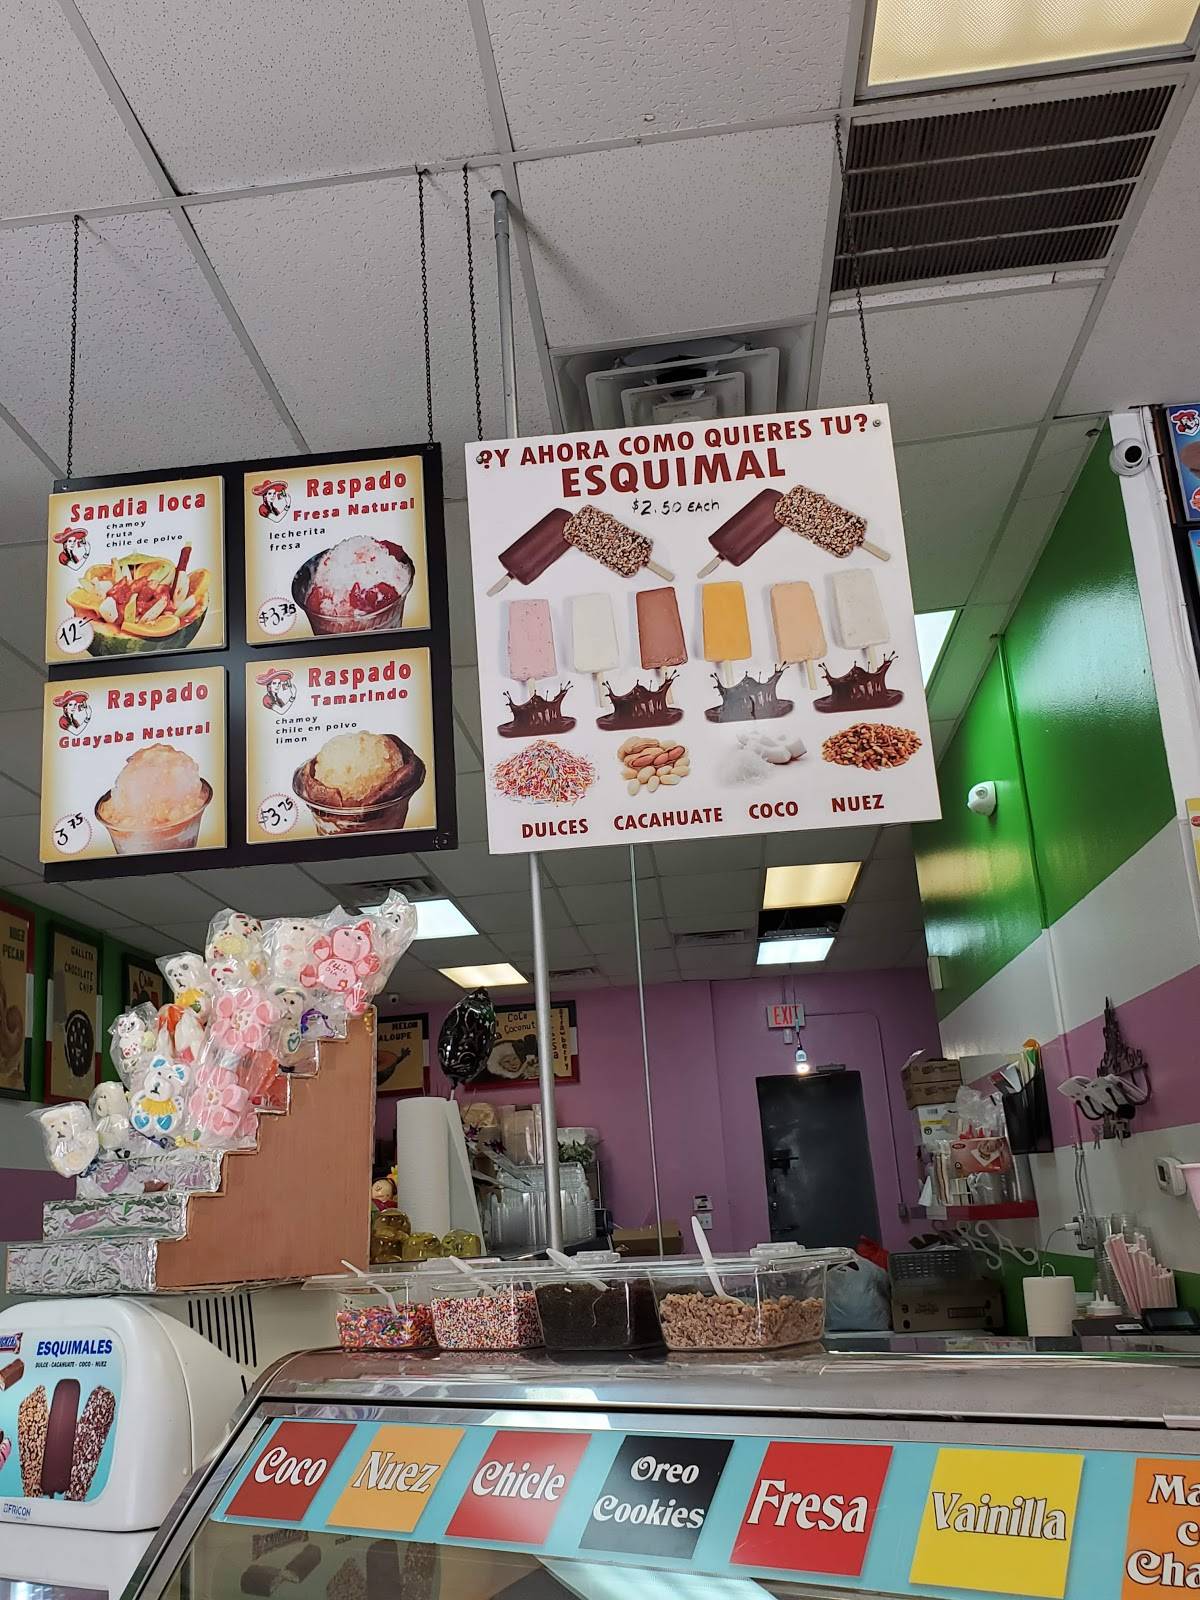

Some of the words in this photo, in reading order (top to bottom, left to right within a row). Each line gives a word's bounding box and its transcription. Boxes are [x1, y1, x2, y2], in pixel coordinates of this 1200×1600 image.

[520, 440, 610, 466] AHORA
[618, 431, 694, 457] COMO
[704, 418, 812, 448] QUIERES
[820, 413, 868, 436] TU?
[306, 470, 407, 499] Raspado
[561, 447, 786, 498] ESQUIMAL
[70, 498, 148, 523] Sandia
[158, 492, 207, 513] loca
[293, 506, 340, 522] Fresa
[348, 497, 415, 516] Natural
[631, 498, 682, 516] $2.50
[106, 519, 147, 531] chamoy
[106, 530, 133, 540] fruta
[269, 527, 326, 540] lecherita
[106, 539, 132, 549] chile
[136, 536, 149, 546] de
[153, 533, 184, 545] polvo
[269, 542, 301, 552] fresa
[259, 602, 297, 627] $3.75
[308, 660, 412, 690] Raspado
[107, 681, 209, 711] Raspado
[310, 687, 408, 707] Tamarindo
[275, 714, 318, 726] chamoy
[275, 724, 304, 735] chile
[308, 724, 321, 732] en
[326, 721, 358, 733] polvo
[58, 730, 135, 749] Guayaba
[142, 721, 210, 740] Natural
[276, 735, 308, 745] limon
[520, 818, 589, 839] DULCES
[612, 806, 724, 831] CACAHUATE
[748, 800, 800, 820] COCO
[830, 793, 886, 813] NUEZ
[773, 1005, 801, 1026] EXIT
[36, 1338, 113, 1359] ESQUIMALES
[254, 1446, 328, 1487] Coco
[352, 1450, 441, 1494] Nuez
[472, 1459, 566, 1501] Chicle
[630, 1455, 700, 1484] Oreo
[592, 1494, 706, 1530] Cookies
[746, 1478, 869, 1533] Fresa
[932, 1491, 1067, 1541] Vainilla
